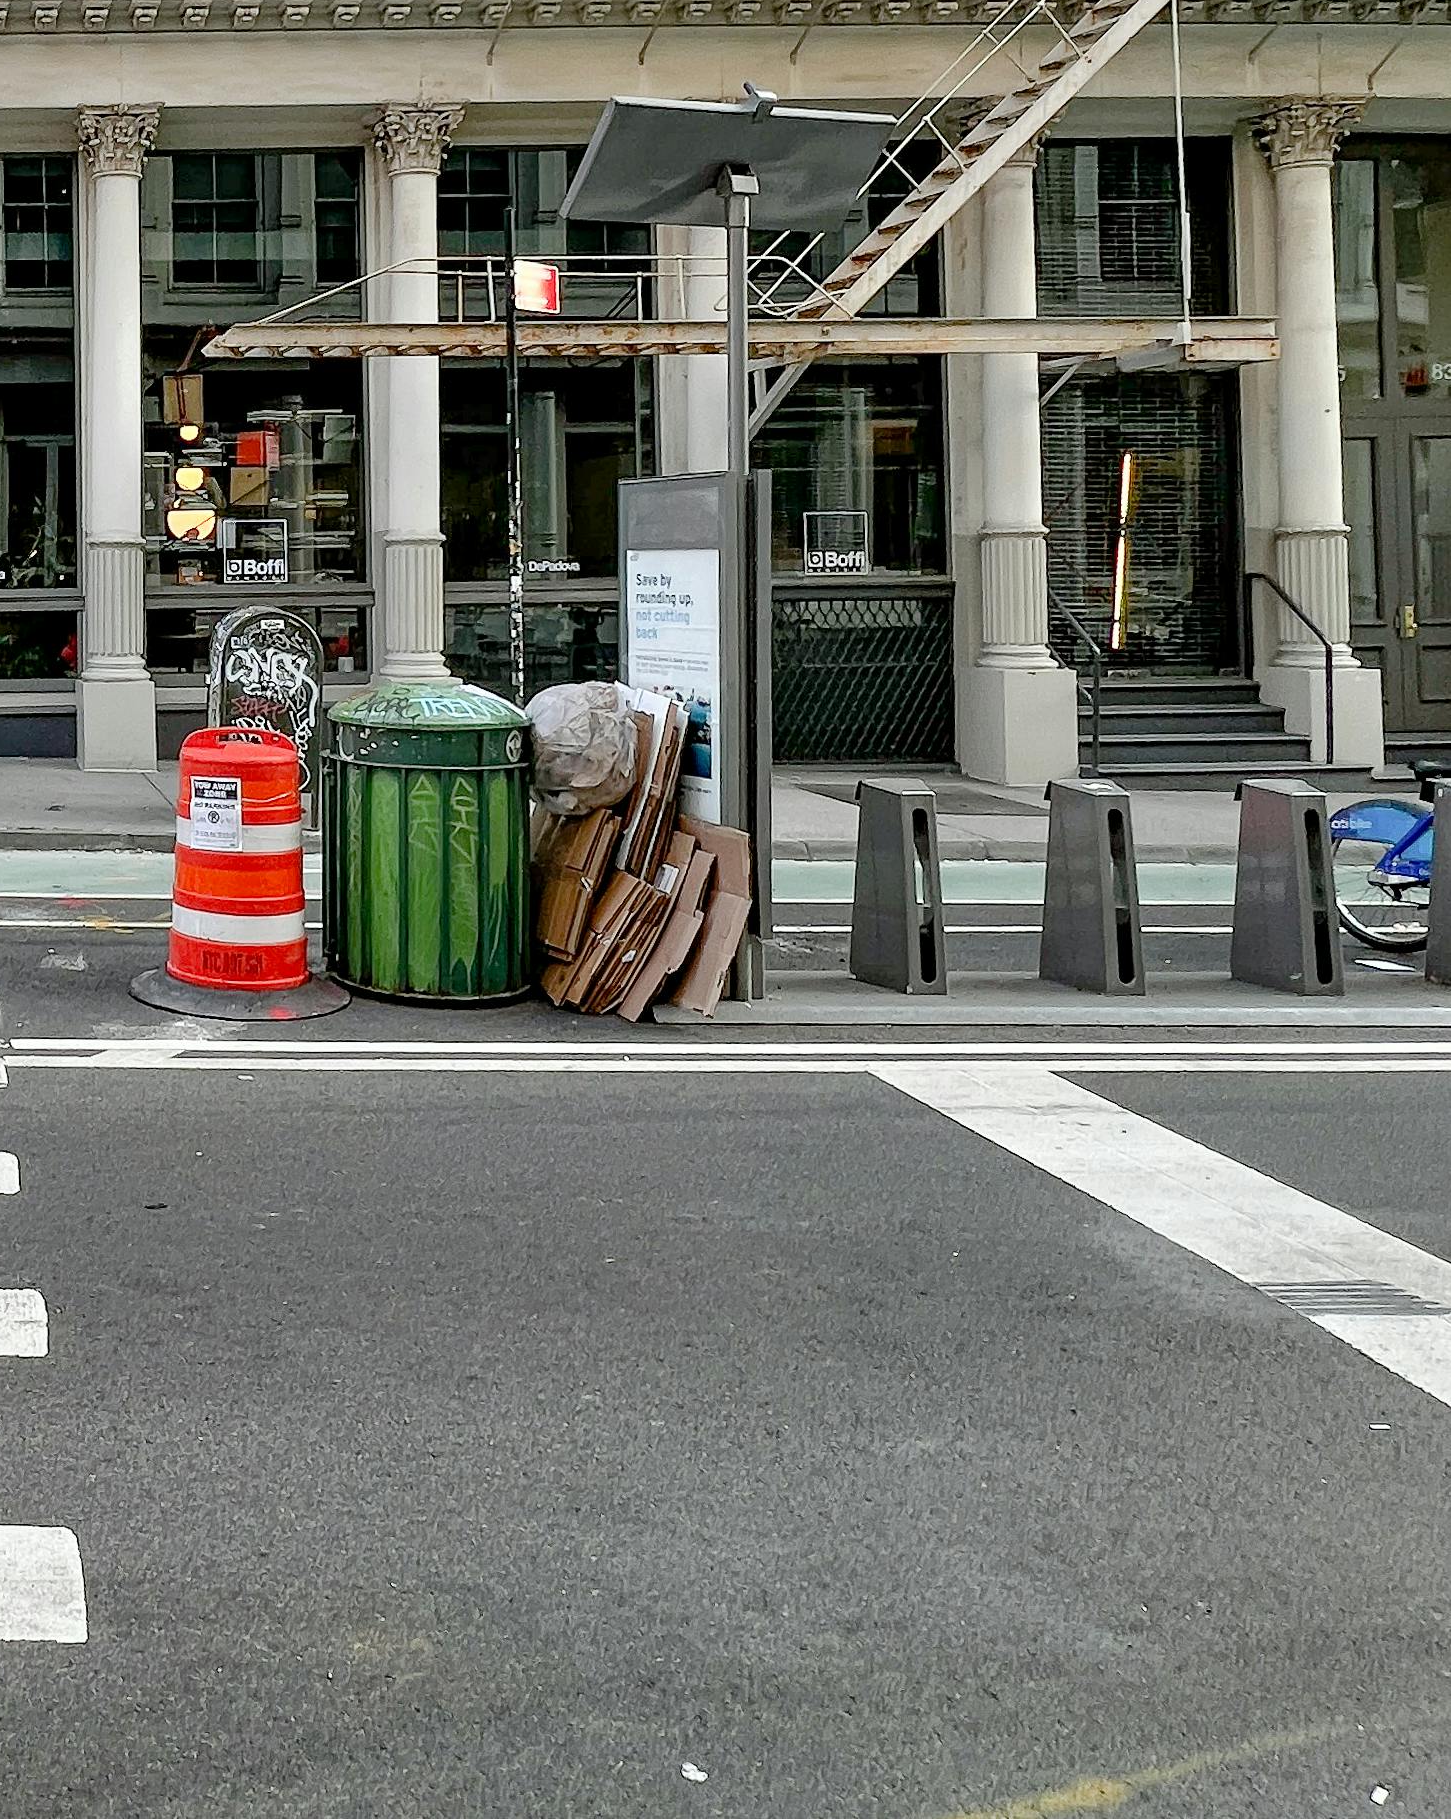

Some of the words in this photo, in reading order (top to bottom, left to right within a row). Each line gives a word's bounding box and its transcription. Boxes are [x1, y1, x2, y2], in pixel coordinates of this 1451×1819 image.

[243, 558, 285, 575] Boffi
[528, 560, 581, 572] DePadova
[825, 550, 865, 568] Boffi
[636, 573, 658, 586] Save
[660, 573, 672, 589] by
[636, 590, 677, 607] rounding
[636, 610, 652, 622] not
[654, 609, 690, 626] cutting
[636, 627, 658, 639] back
[212, 782, 237, 791] AWAY
